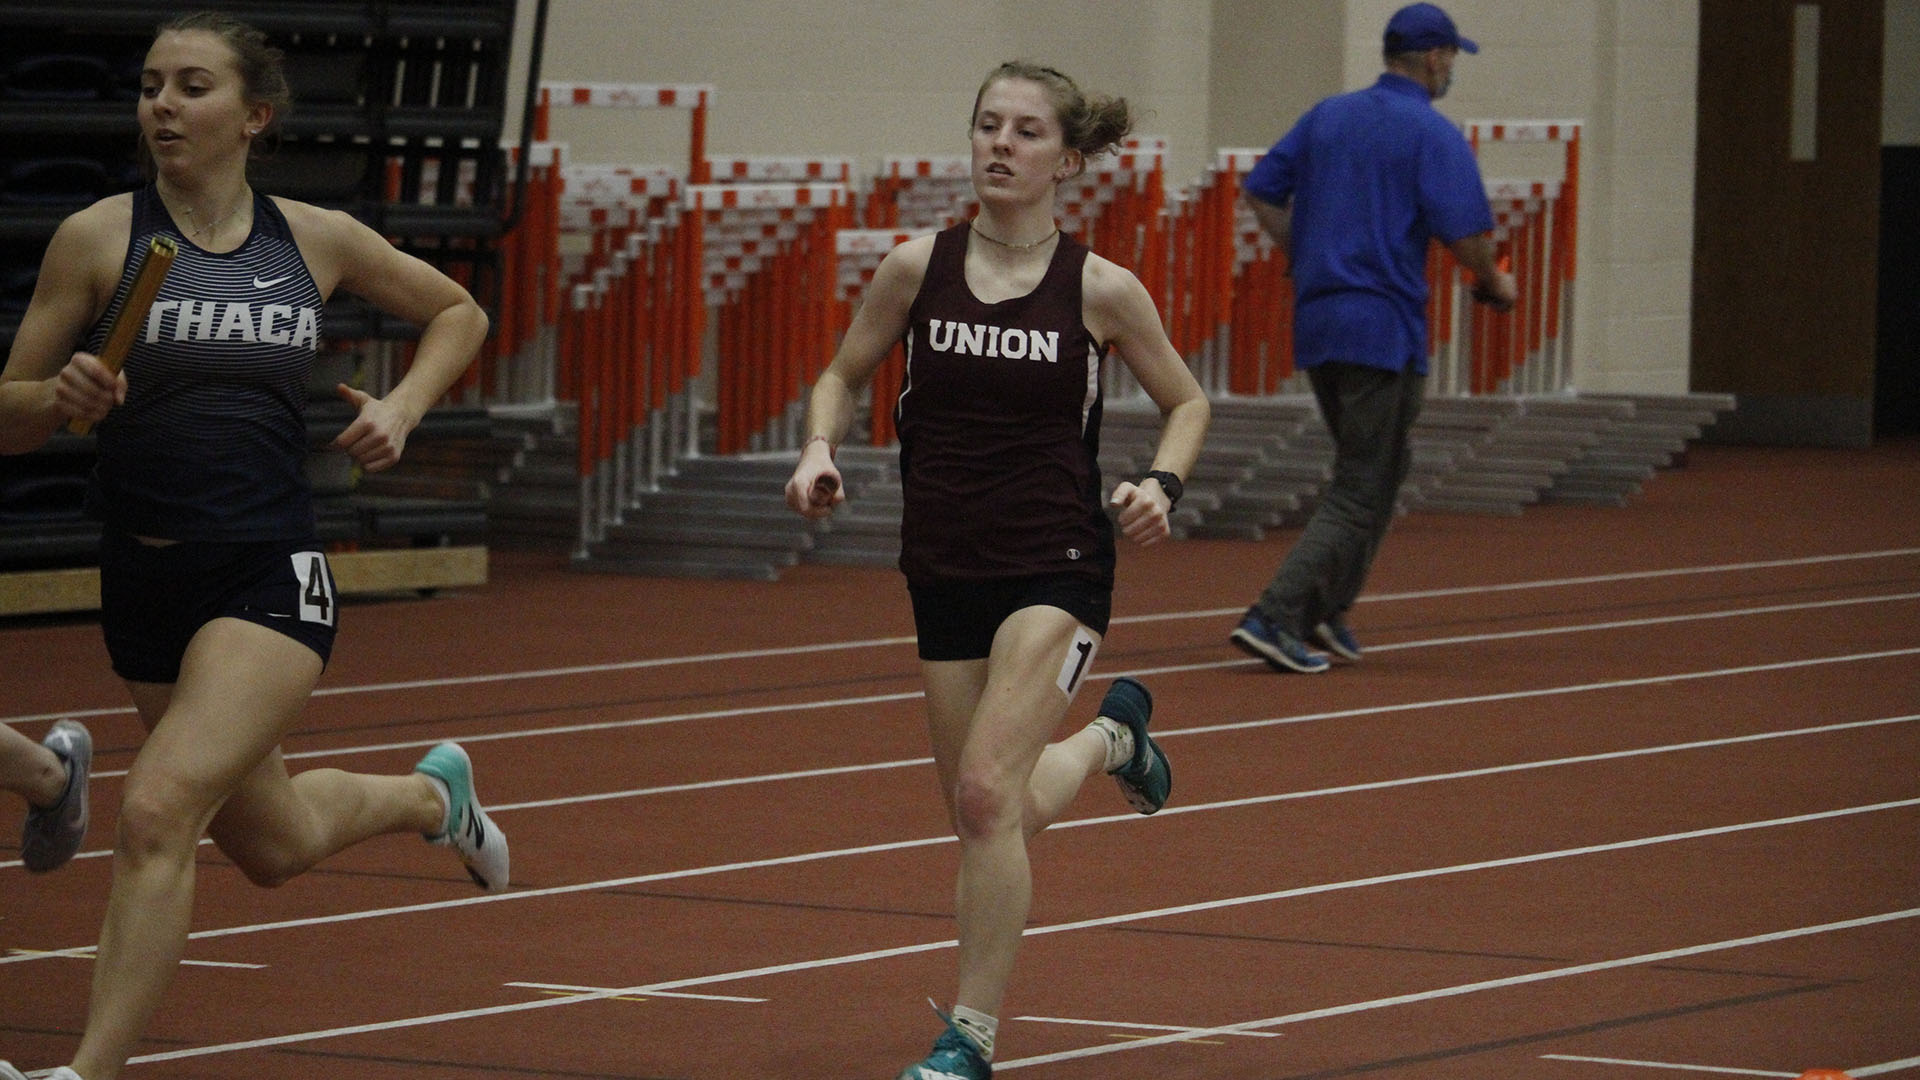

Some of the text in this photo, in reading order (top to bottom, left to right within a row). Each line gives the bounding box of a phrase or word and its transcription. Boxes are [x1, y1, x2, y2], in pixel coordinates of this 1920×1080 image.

[145, 300, 317, 350] THACA
[929, 319, 1060, 363] UNION
[305, 556, 329, 621] 4
[1066, 641, 1093, 694] 1
